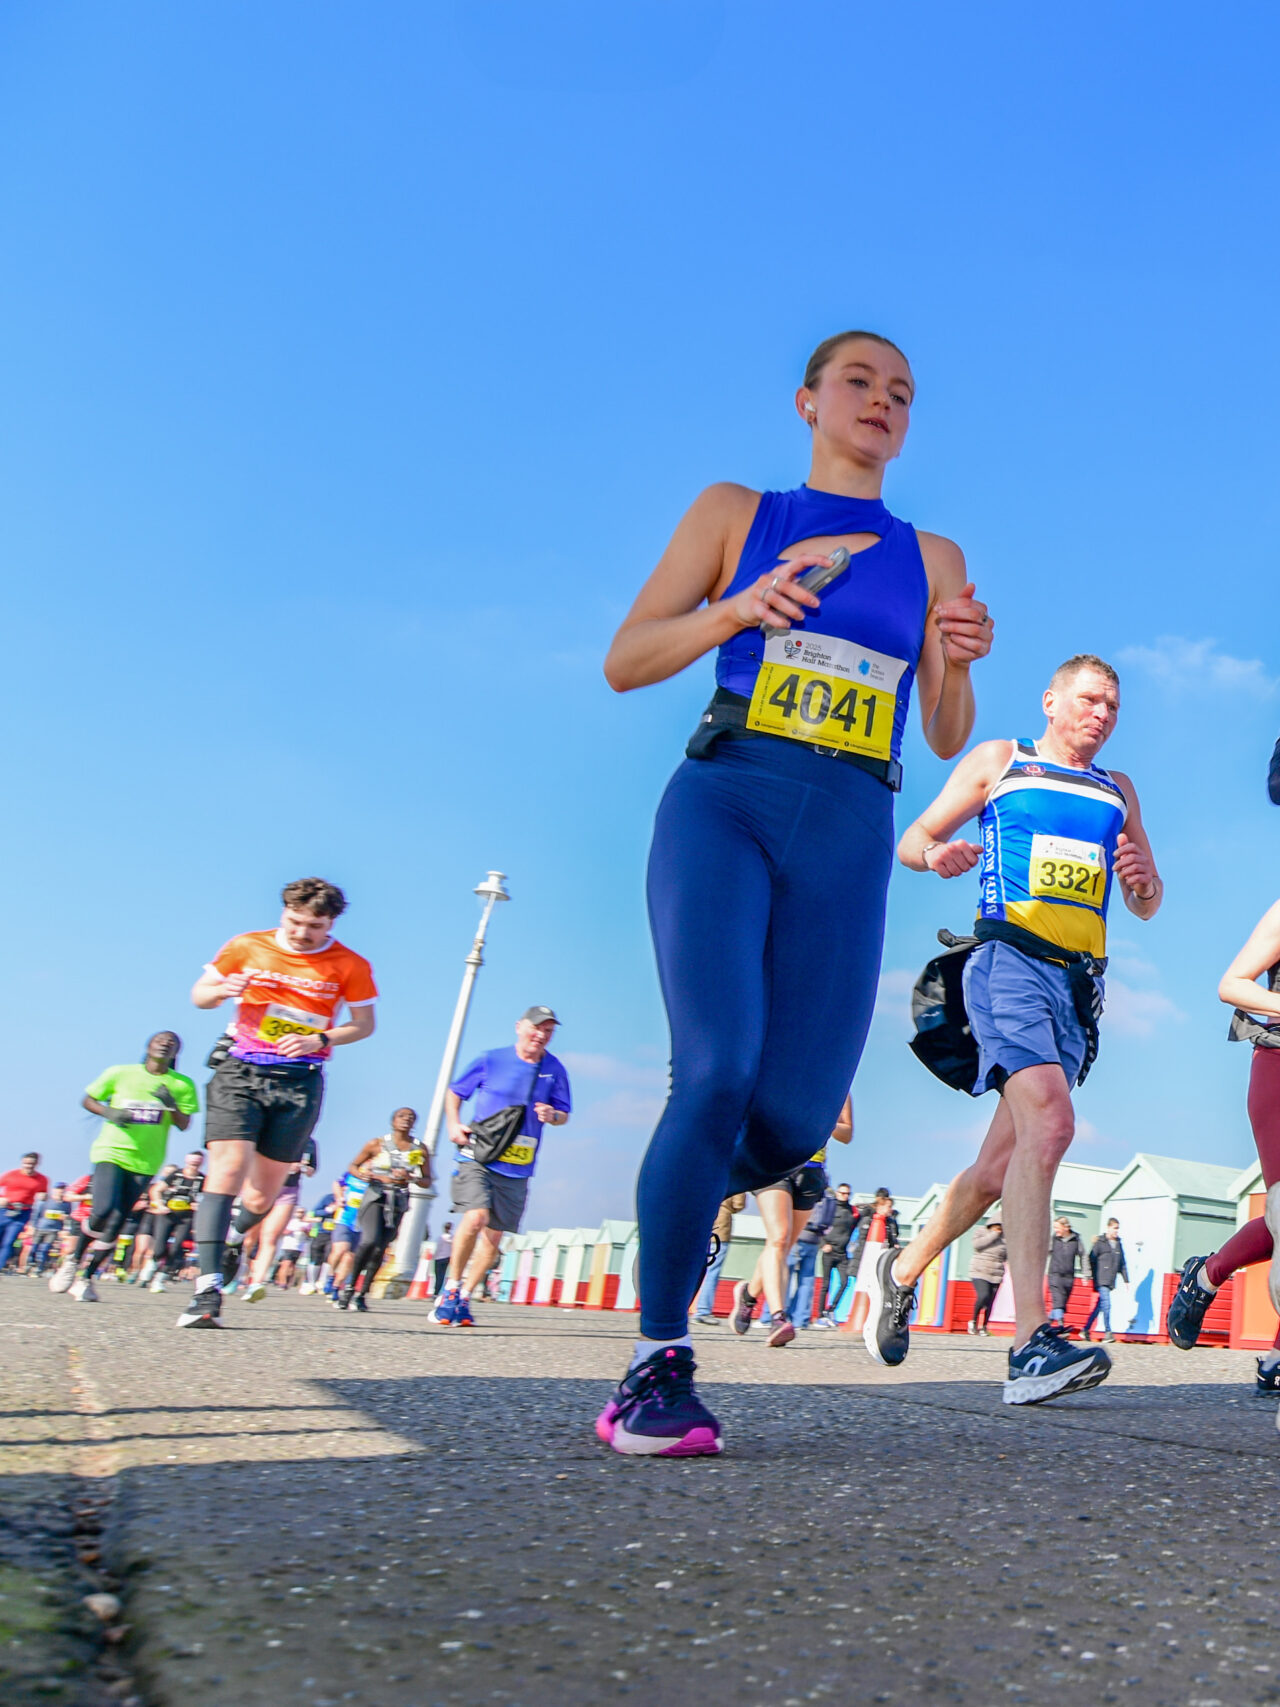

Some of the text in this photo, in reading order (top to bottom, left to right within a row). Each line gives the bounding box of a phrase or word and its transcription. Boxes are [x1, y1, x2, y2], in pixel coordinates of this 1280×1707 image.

[801, 656, 817, 665] Half
[803, 650, 832, 661] Brighton
[768, 673, 877, 738] 4041
[984, 823, 996, 872] RUGBY
[1040, 861, 1102, 897] 3321
